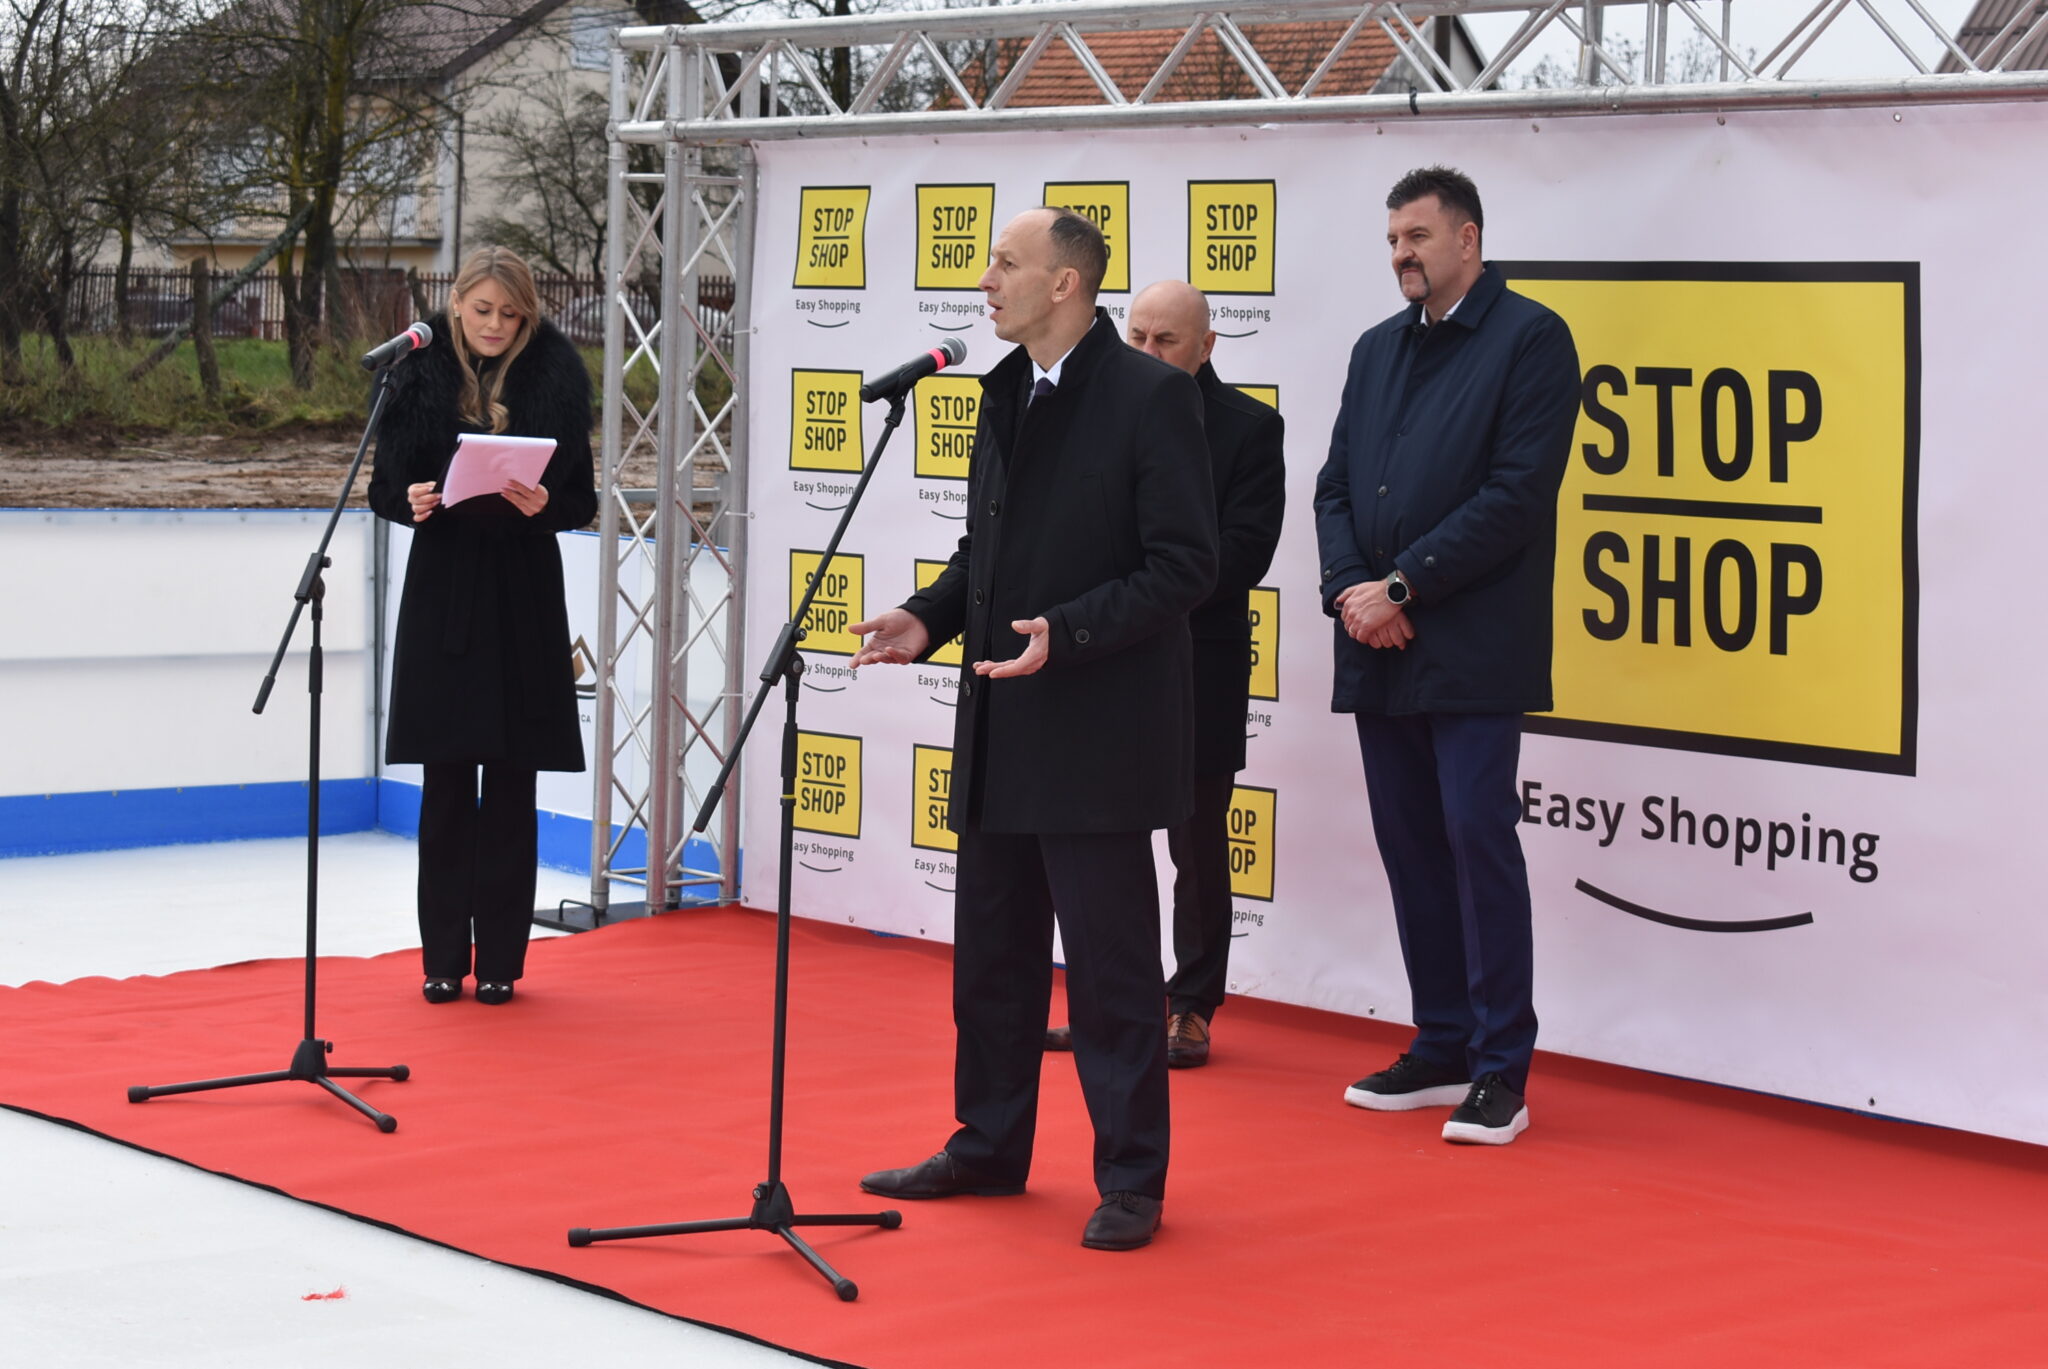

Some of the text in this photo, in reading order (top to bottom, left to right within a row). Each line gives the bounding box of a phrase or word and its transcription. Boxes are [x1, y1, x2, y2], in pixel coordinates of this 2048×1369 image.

[813, 207, 854, 232] STOP
[932, 206, 977, 231] STOP
[1206, 203, 1258, 231] STOP
[809, 243, 849, 268] SHOP
[931, 243, 975, 269] SHOP
[1206, 244, 1257, 271] SHOP
[795, 299, 861, 313] Easy Shopping
[918, 301, 985, 316] Easy Shopping
[1220, 306, 1271, 322] Shopping
[806, 390, 847, 416] STOP
[930, 395, 976, 421] STOP
[1581, 363, 1823, 484] STOP
[804, 426, 847, 452] SHOP
[793, 480, 856, 497] Easy Shoppin
[918, 488, 941, 504] Easy
[1581, 530, 1823, 656] SHOP
[804, 607, 848, 634] SHOP
[815, 663, 858, 680] Shopping
[917, 674, 939, 689] Easy
[802, 751, 846, 779] STOP
[800, 786, 846, 815] SHOP
[1522, 780, 1880, 883] Easy Shopping
[793, 842, 855, 862] asy Shopping
[914, 858, 936, 874] Easy
